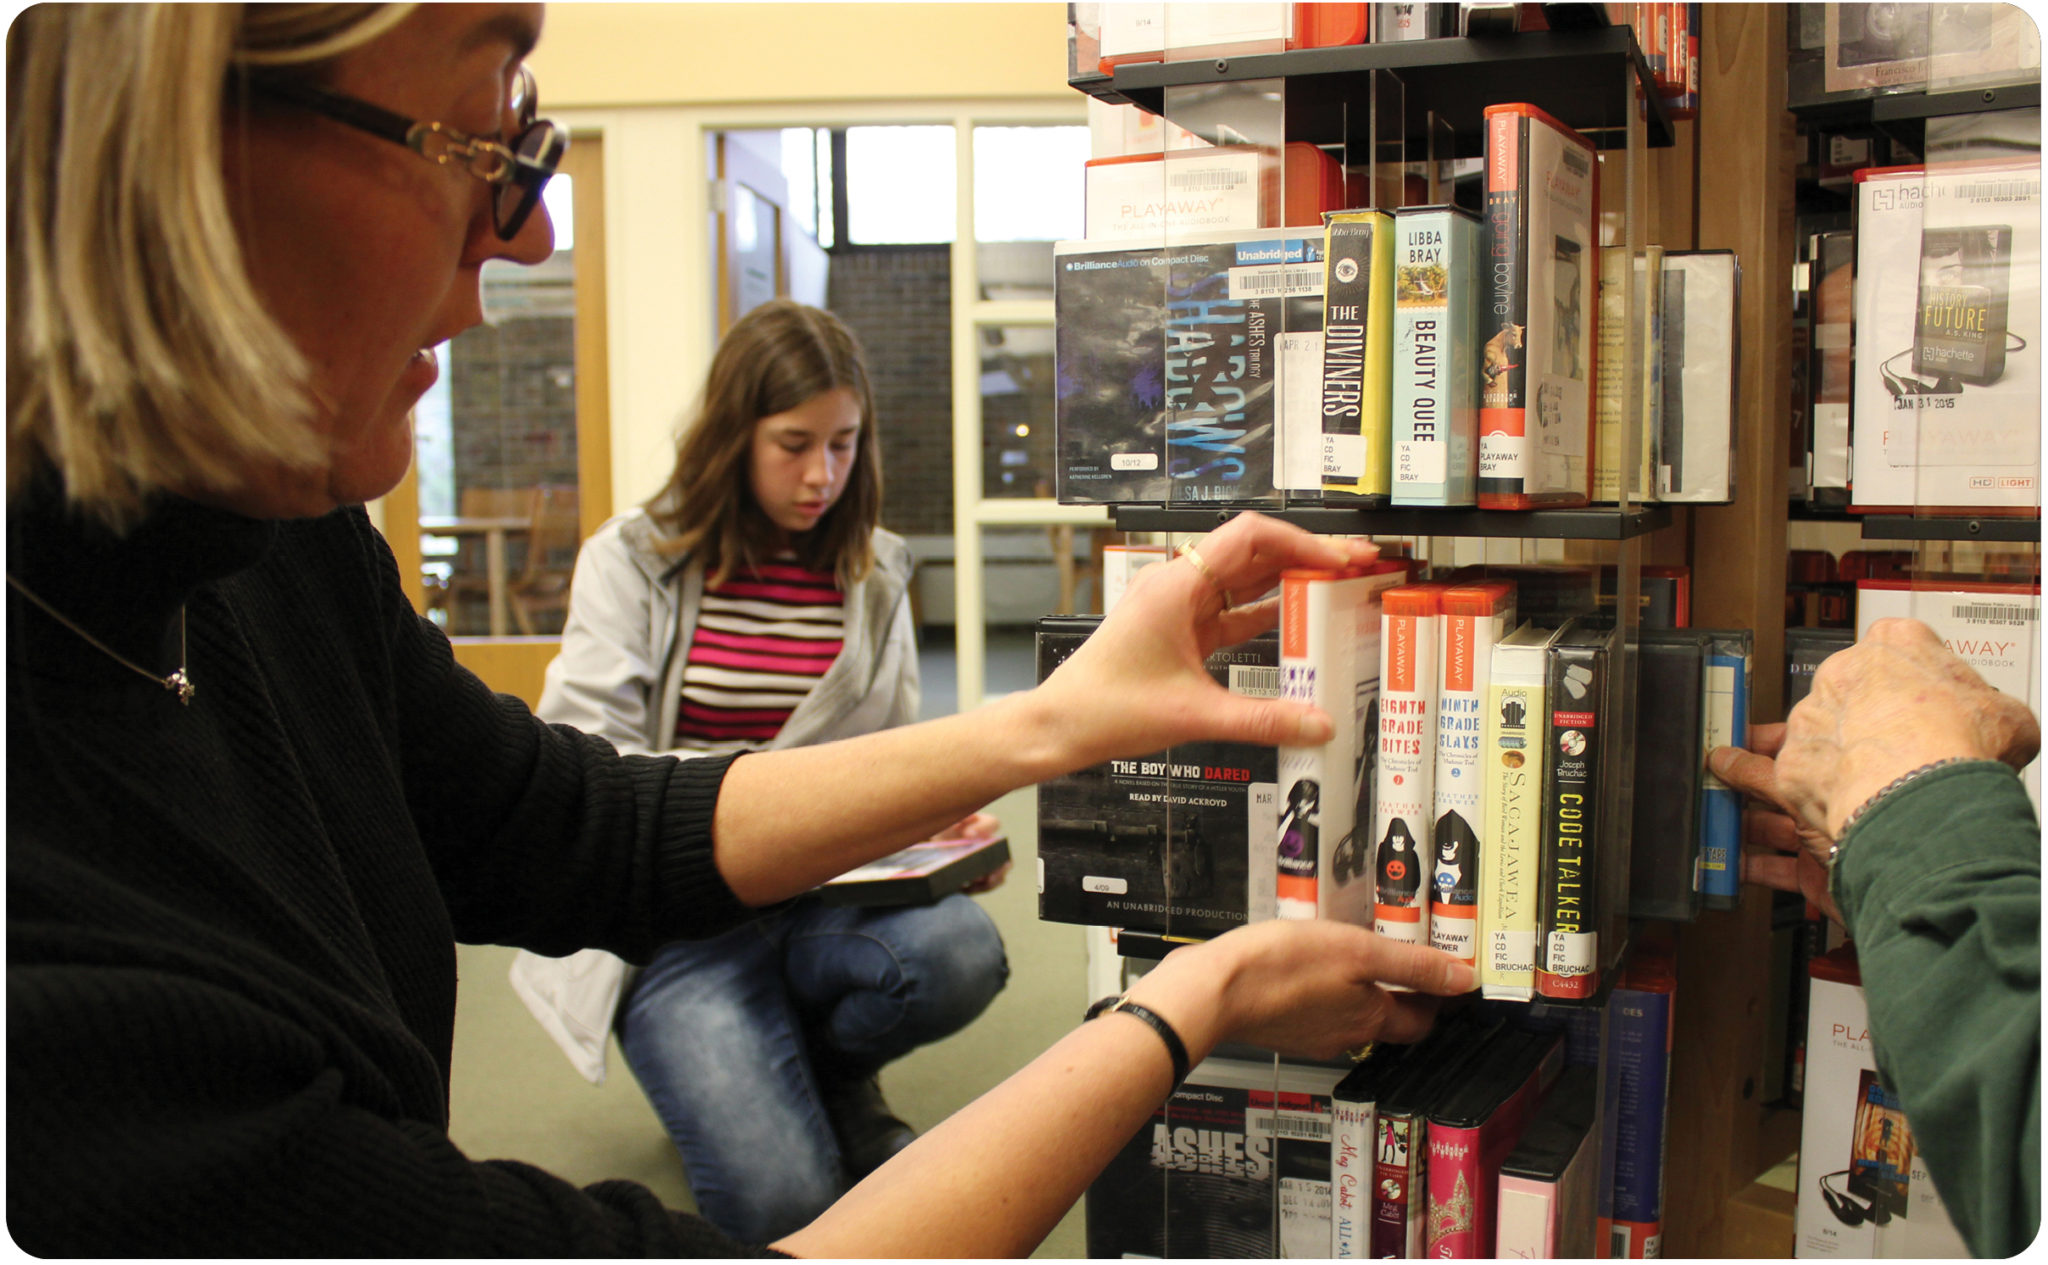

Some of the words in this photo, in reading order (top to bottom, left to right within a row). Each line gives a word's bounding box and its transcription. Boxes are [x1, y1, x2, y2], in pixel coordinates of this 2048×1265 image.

[1497, 120, 1507, 185] PLAYAWAY
[1409, 231, 1442, 246] LIBBA
[1491, 212, 1510, 257] going
[1152, 256, 1188, 266] Compact
[1190, 254, 1209, 263] Disc
[1410, 248, 1441, 263] BRAY
[1494, 262, 1514, 315] bovine
[1930, 292, 1968, 308] HISTORY
[1331, 305, 1359, 321] THE
[1924, 305, 1987, 332] FUTURE
[1248, 311, 1265, 347] ASHES
[1963, 331, 1983, 340] KING
[1414, 320, 1436, 389] BEAUTY
[1935, 347, 1975, 362] hachette
[1323, 325, 1363, 417] DIVINERS
[1413, 397, 1435, 441] QUEE
[1323, 465, 1341, 473] BRAY
[2001, 479, 2031, 487] LIGHT
[1201, 485, 1212, 500] J.
[1397, 619, 1406, 682] PLAYAWAY
[1455, 619, 1465, 682] PLAYAWAY
[1944, 640, 2010, 656] AWAY
[1968, 658, 2015, 668] DIOBOOK
[1501, 688, 1527, 697] Audio
[1381, 698, 1425, 714] EIGHTH
[1441, 698, 1479, 713] NINTH
[1381, 718, 1423, 735] GRADE
[1440, 716, 1480, 731] GRADE
[1382, 738, 1421, 755] BITES
[1440, 734, 1478, 749] SLAYS
[1111, 760, 1137, 774] THE
[1141, 762, 1166, 776] BOY
[1169, 764, 1200, 778] WHO
[1204, 766, 1250, 781] DARED
[1556, 768, 1587, 777] Bruchac
[1559, 761, 1585, 769] Joseph
[1130, 793, 1151, 801] READ
[1152, 794, 1162, 802] BY
[1188, 798, 1228, 807] ACKROYD
[1256, 793, 1272, 804] MAR
[1558, 793, 1583, 848] CODE
[1556, 856, 1581, 933] TALKER
[1107, 901, 1120, 909] AN
[1123, 902, 1183, 915] UNABRIDGED
[1185, 907, 1248, 921] PRODUCTION
[1377, 925, 1385, 933] YA
[1553, 954, 1566, 962] FIC
[1495, 963, 1534, 971] BRUCHAC
[1552, 964, 1590, 973] BRUCHAC
[1174, 1091, 1204, 1101] ompact
[1205, 1093, 1224, 1102] Disc
[1150, 1124, 1272, 1181] ASHES
[1335, 1134, 1359, 1167] Meg
[1339, 1174, 1358, 1210] Cabot
